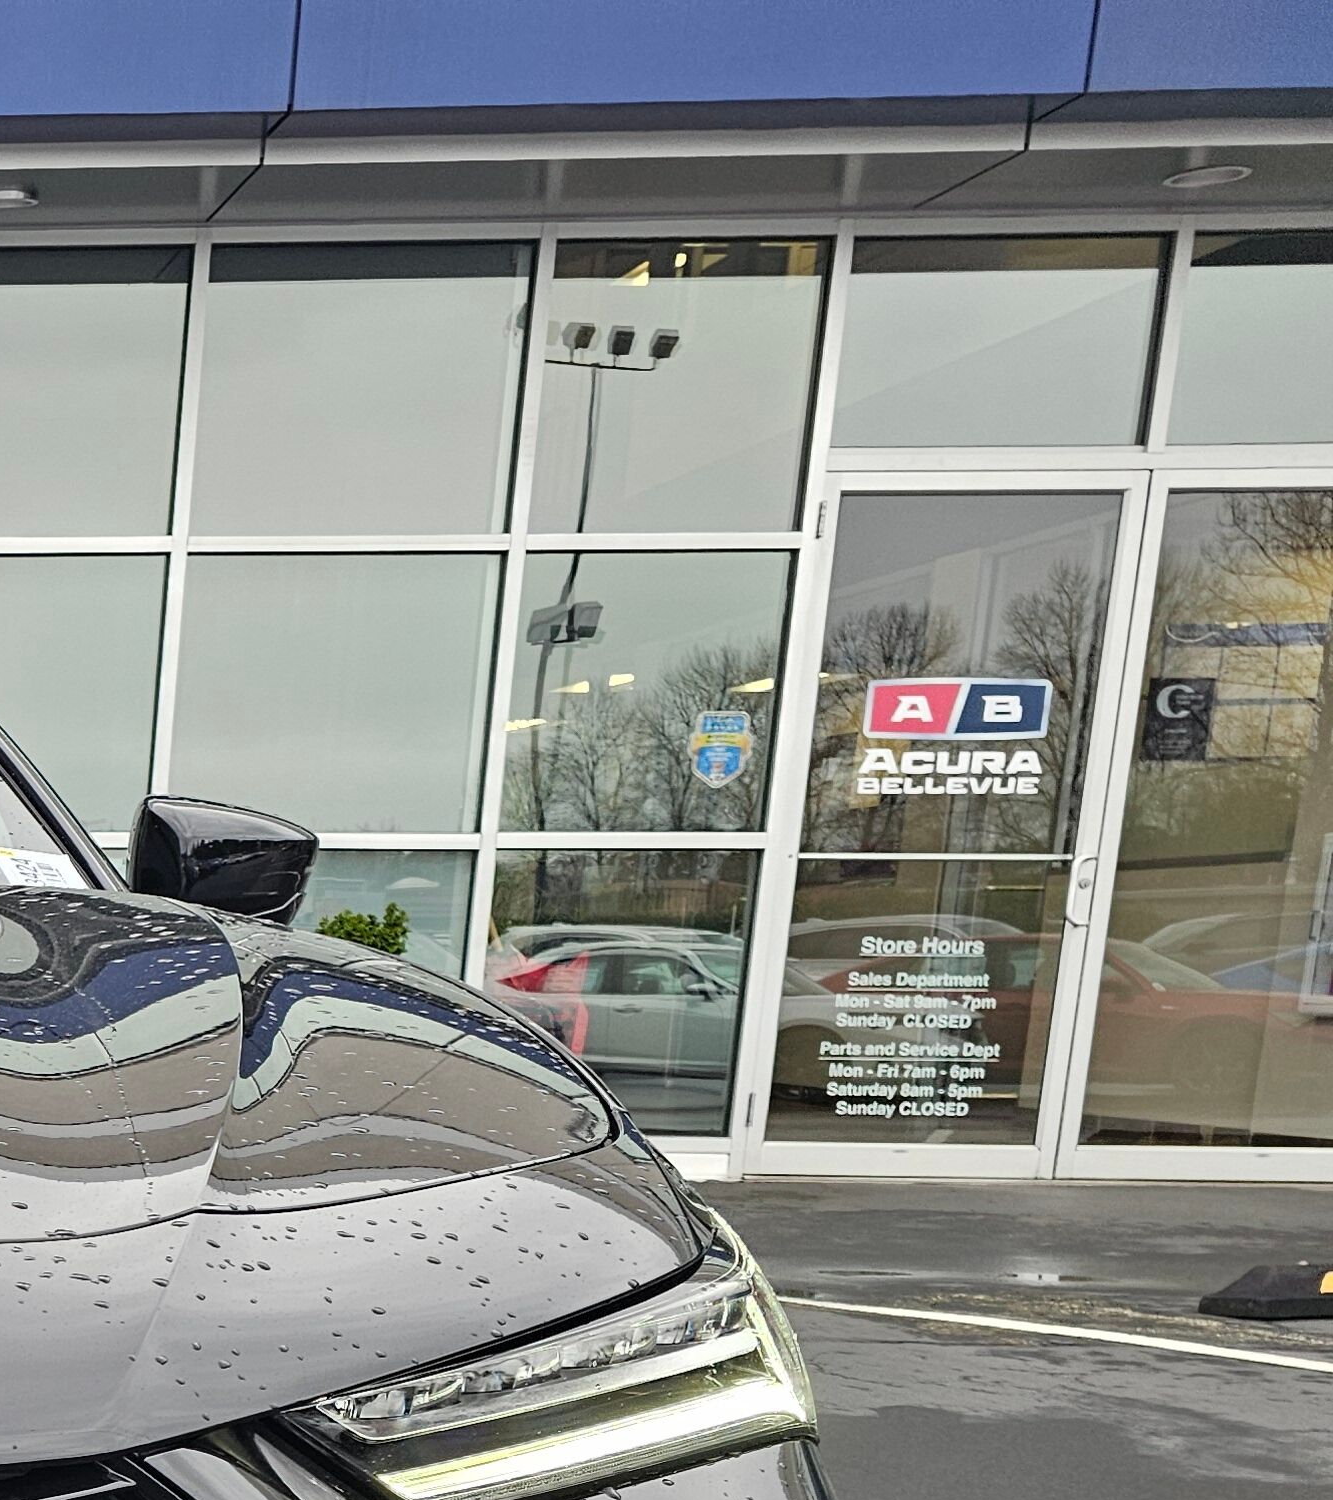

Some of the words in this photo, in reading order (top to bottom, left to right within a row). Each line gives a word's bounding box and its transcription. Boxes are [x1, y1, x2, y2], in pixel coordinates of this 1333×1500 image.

[890, 695, 933, 722] A
[981, 695, 1023, 722] B
[857, 748, 1043, 774] ACURA
[856, 776, 1041, 795] BELLEVUE
[860, 936, 918, 954] Store
[921, 936, 985, 954] Hours
[847, 971, 892, 987] Sales
[895, 972, 990, 989] Department
[835, 993, 869, 1008] Mon
[883, 994, 911, 1009] Sat
[913, 994, 949, 1009] 9am
[961, 994, 997, 1012] 7pm
[835, 1013, 897, 1030] Sunday
[902, 1013, 972, 1029] CLOSED
[819, 1041, 862, 1056] Parts
[864, 1041, 896, 1056] and
[898, 1041, 960, 1057] Service
[962, 1042, 1001, 1059] Dept
[828, 1063, 863, 1078] Mon
[877, 1063, 899, 1078] Fri
[902, 1064, 937, 1079] 7am
[949, 1065, 985, 1082] 6pm
[826, 1082, 898, 1099] Saturday
[948, 1084, 983, 1101] 5pm
[835, 1101, 896, 1119] Sunday
[898, 1101, 969, 1117] CLOSED
